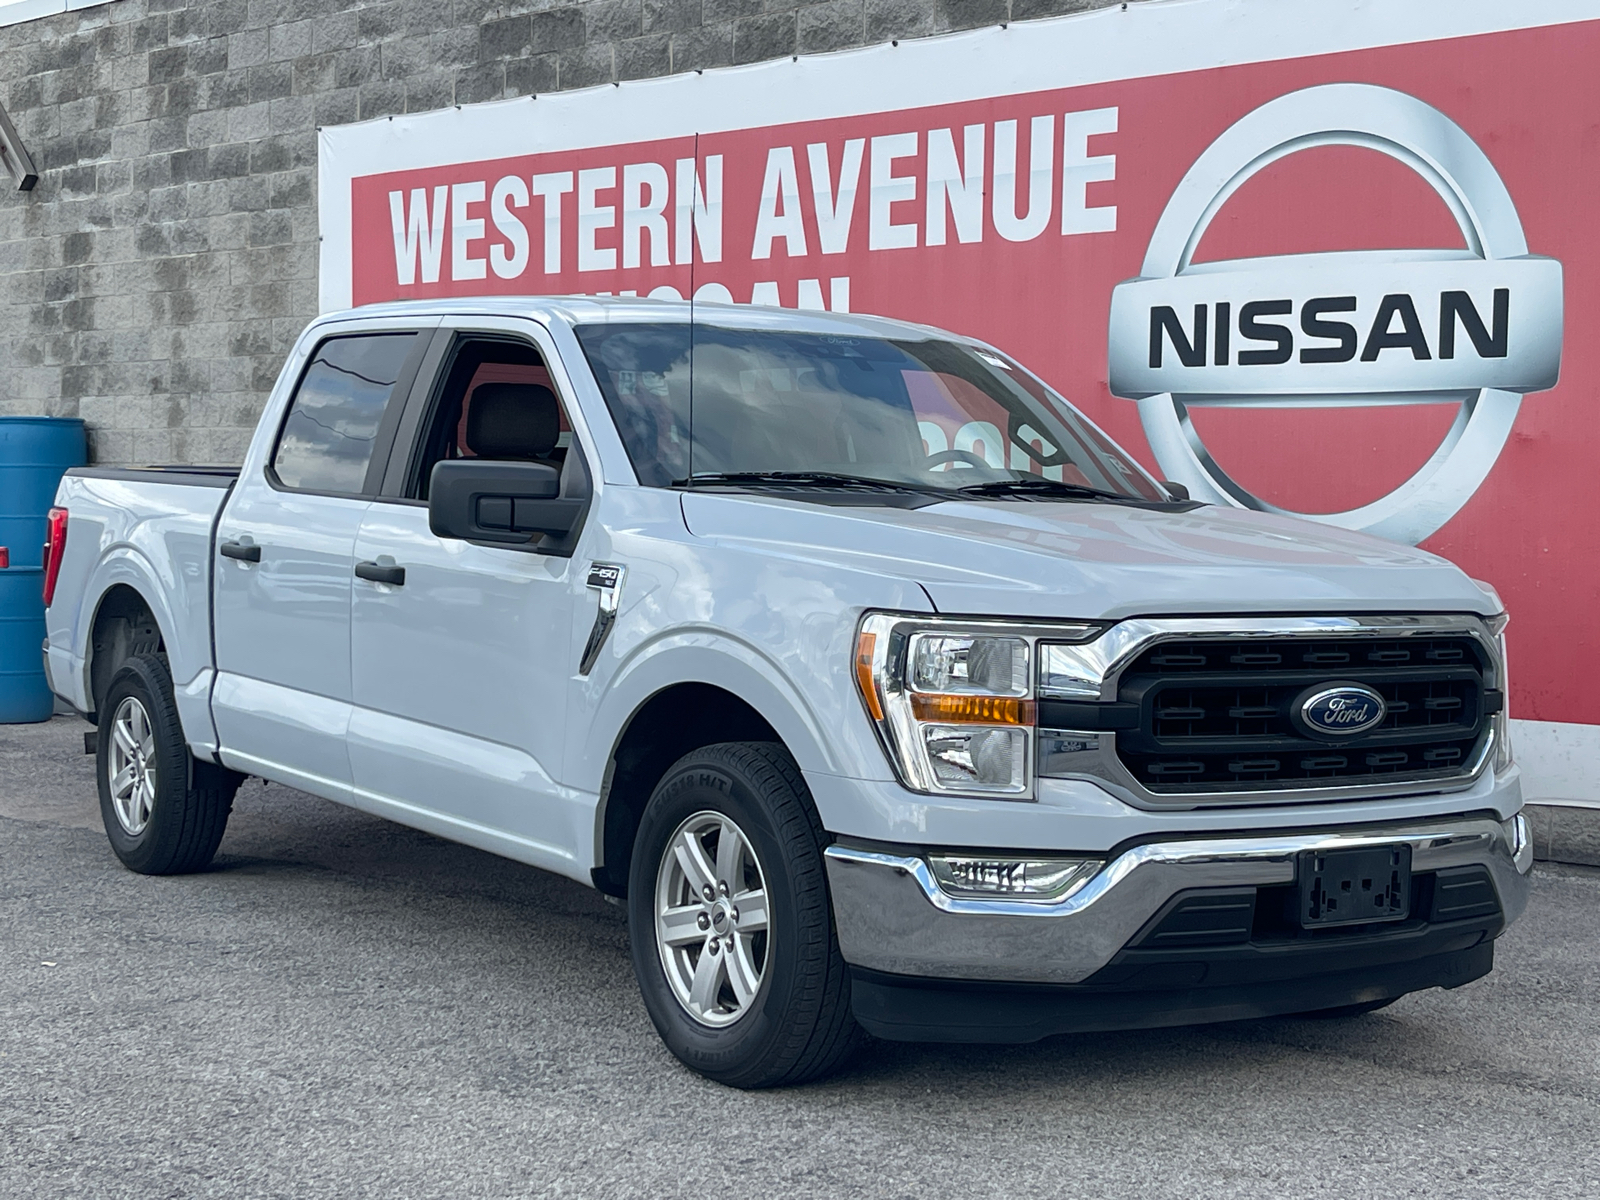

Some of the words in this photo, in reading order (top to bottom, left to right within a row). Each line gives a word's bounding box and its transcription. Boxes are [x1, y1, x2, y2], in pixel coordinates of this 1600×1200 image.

[389, 155, 723, 285] WESTERN
[751, 106, 1119, 260] AVENUE
[1149, 287, 1510, 369] NISSAN
[1323, 698, 1368, 724] Ford
